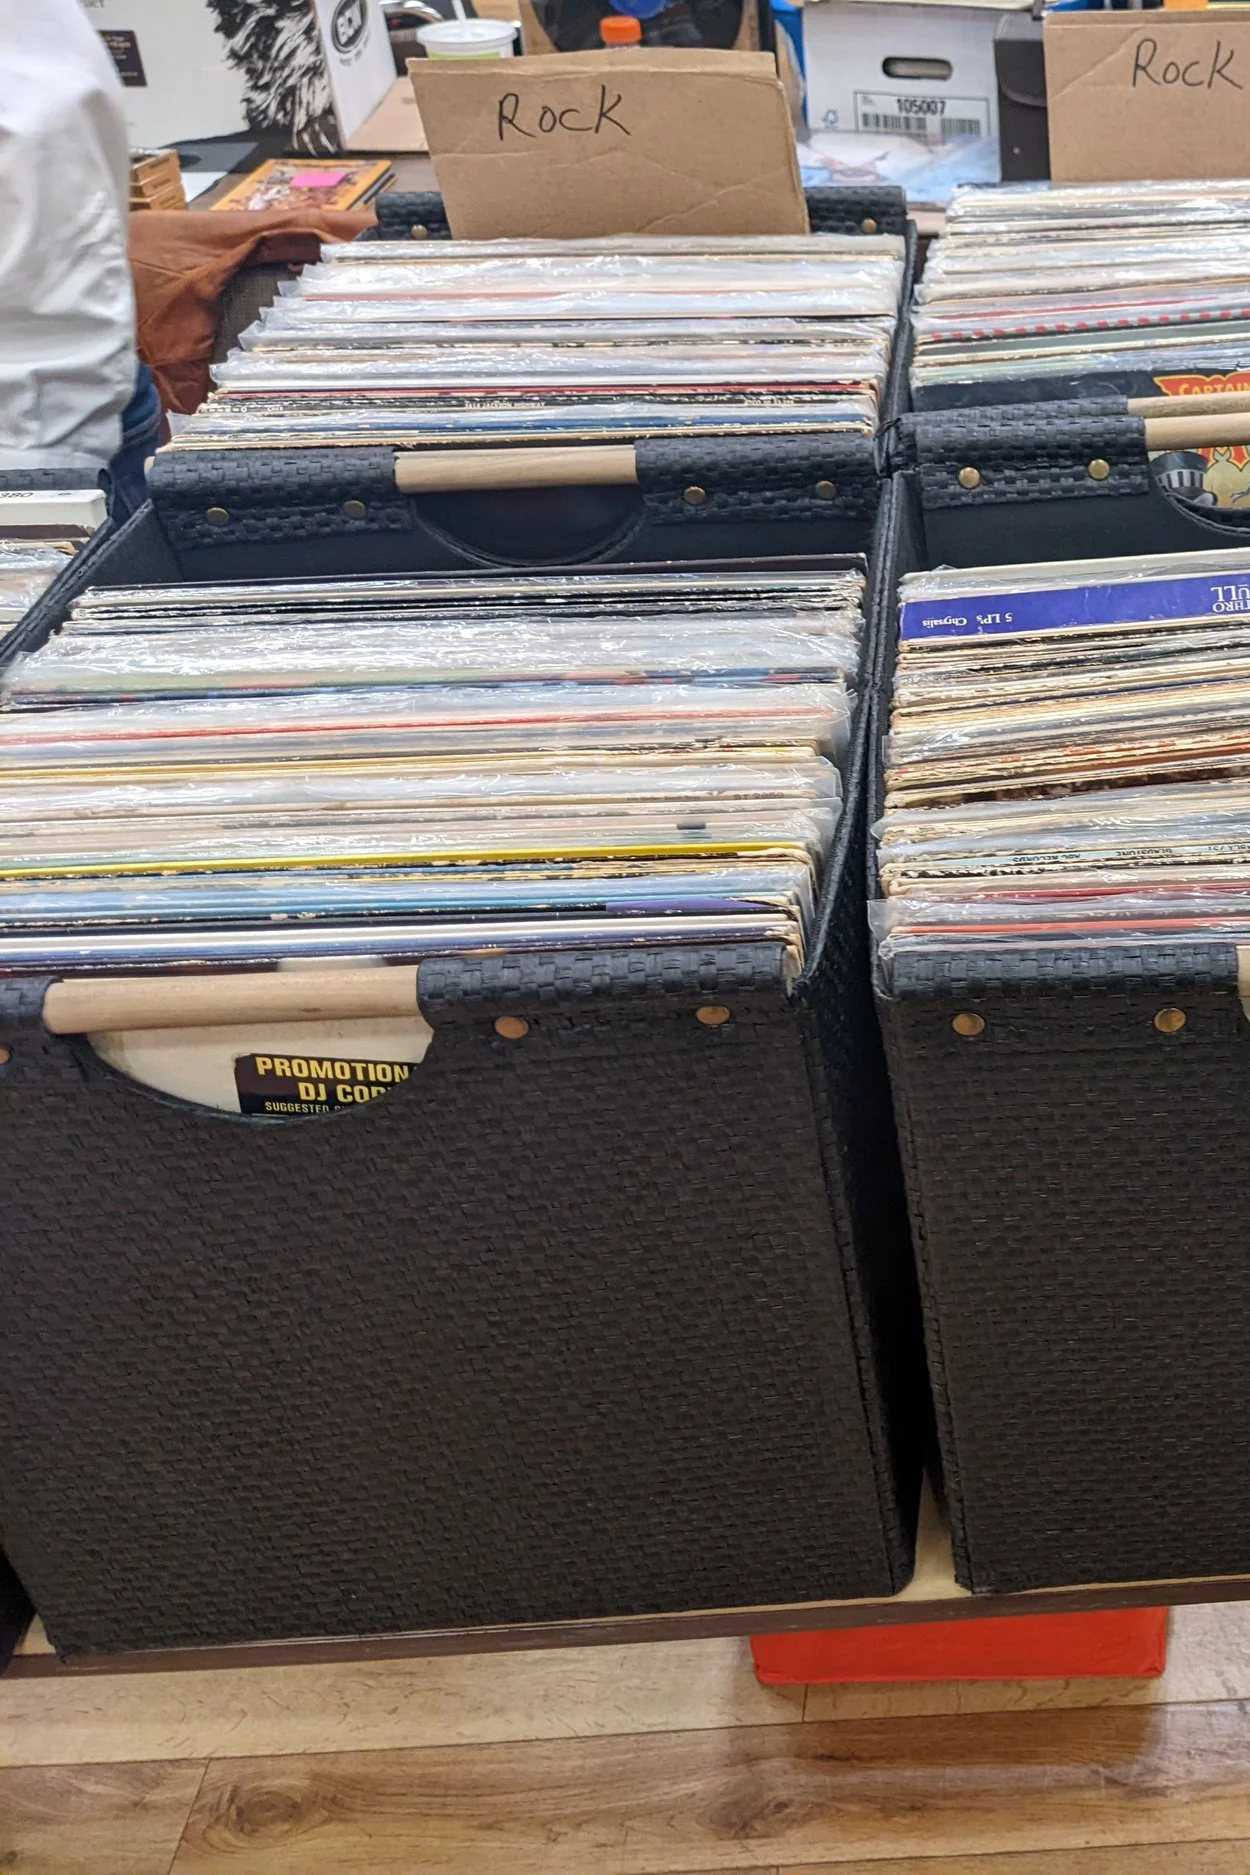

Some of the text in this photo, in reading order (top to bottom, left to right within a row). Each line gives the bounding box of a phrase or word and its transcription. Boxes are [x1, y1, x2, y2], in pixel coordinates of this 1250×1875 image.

[896, 98, 946, 116] 105007
[922, 615, 967, 628] Chrysalis
[1004, 612, 1013, 622] 5
[255, 1056, 419, 1084] PROMOTION
[298, 1082, 393, 1104] DJ COP
[264, 1101, 330, 1114] SUGGESTED
